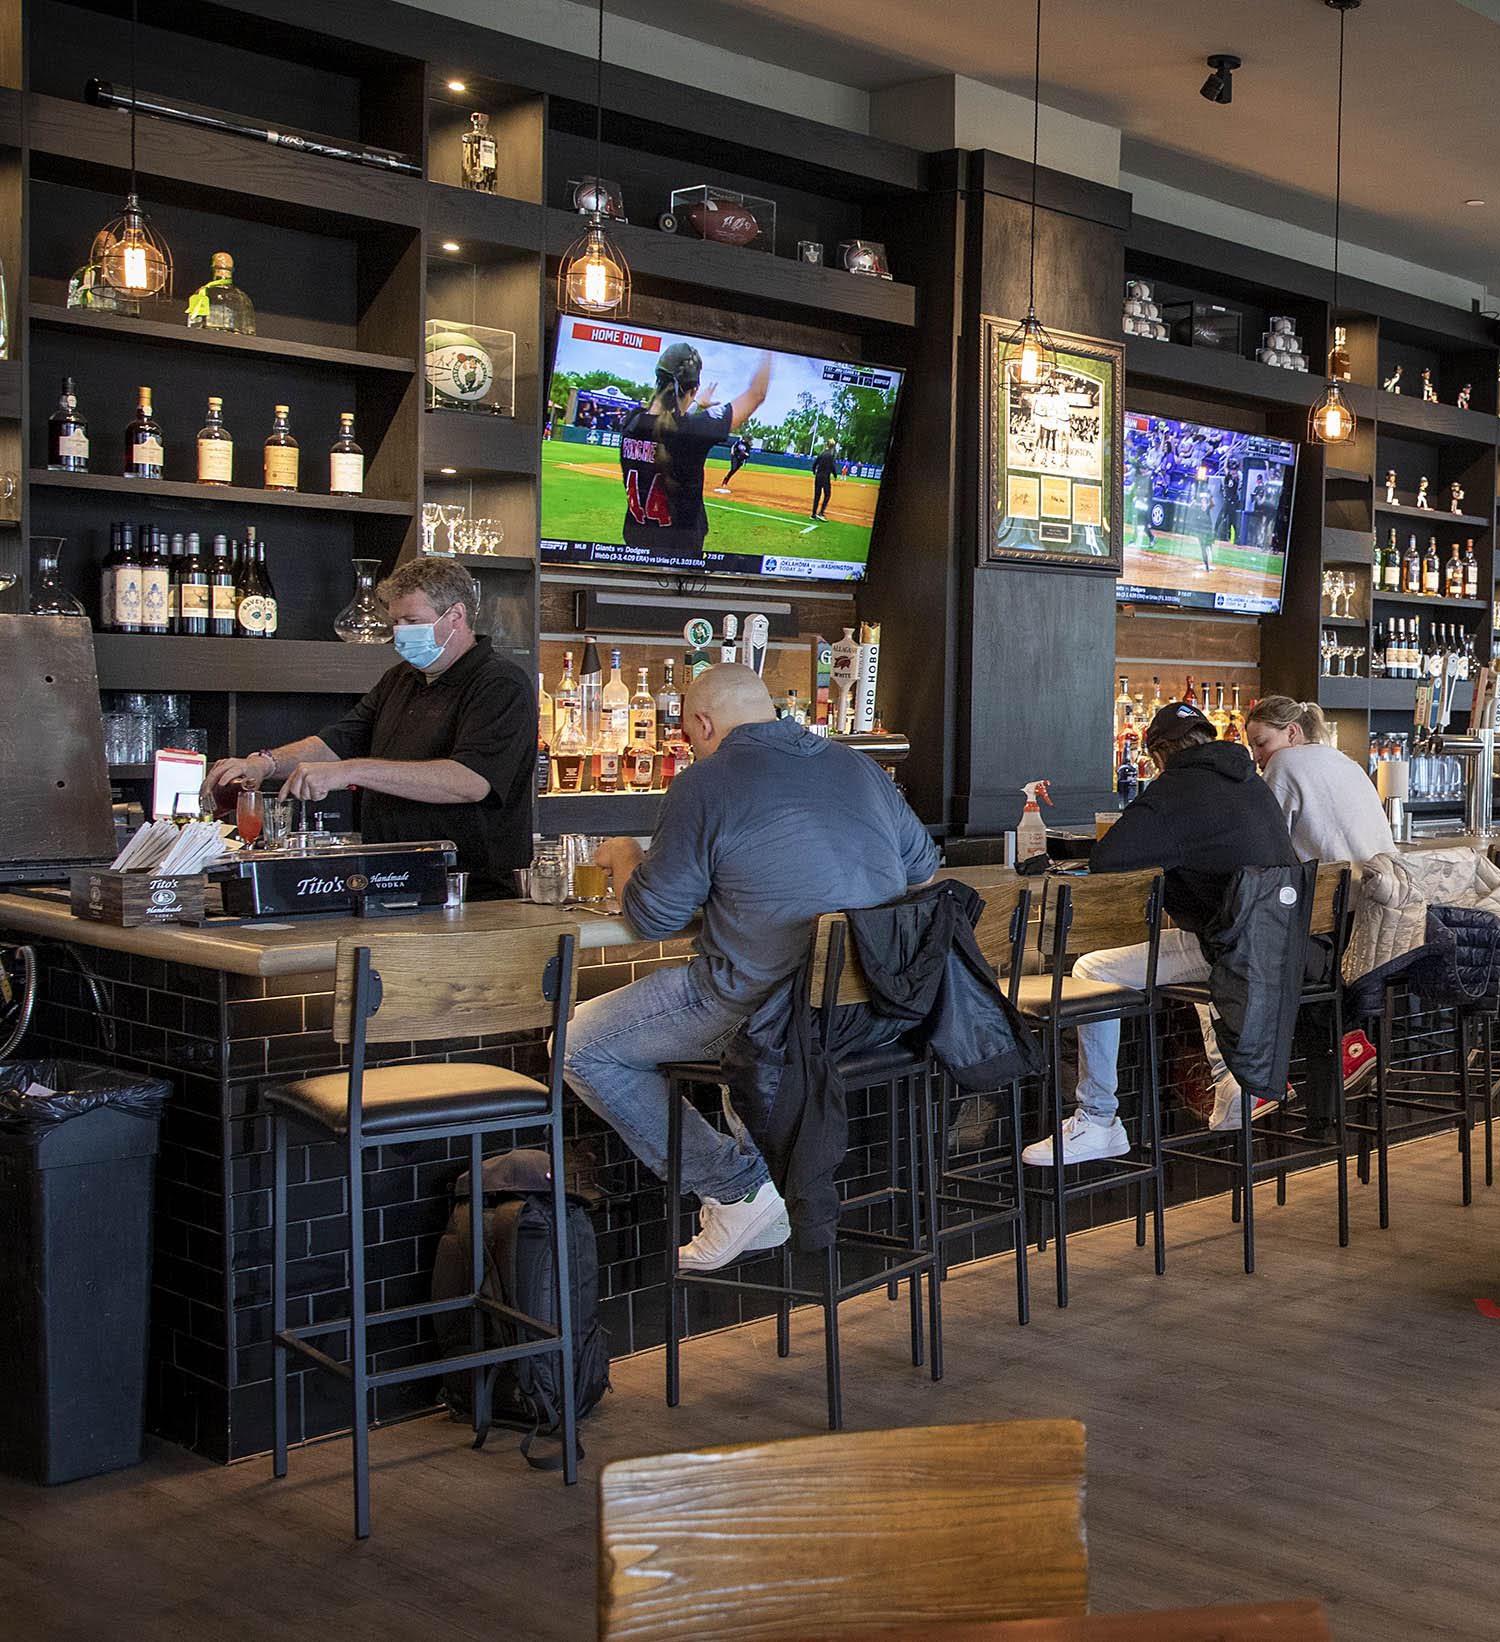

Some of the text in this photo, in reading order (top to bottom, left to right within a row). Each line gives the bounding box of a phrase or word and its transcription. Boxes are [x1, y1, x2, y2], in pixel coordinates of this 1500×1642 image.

[591, 328, 643, 348] HOME RUN
[594, 552, 610, 560] Webb
[595, 543, 615, 552] Giants
[625, 546, 650, 555] Dodgers
[865, 646, 878, 722] LORD HOBO
[149, 879, 179, 890] Tito's
[297, 876, 345, 896] Tito's
